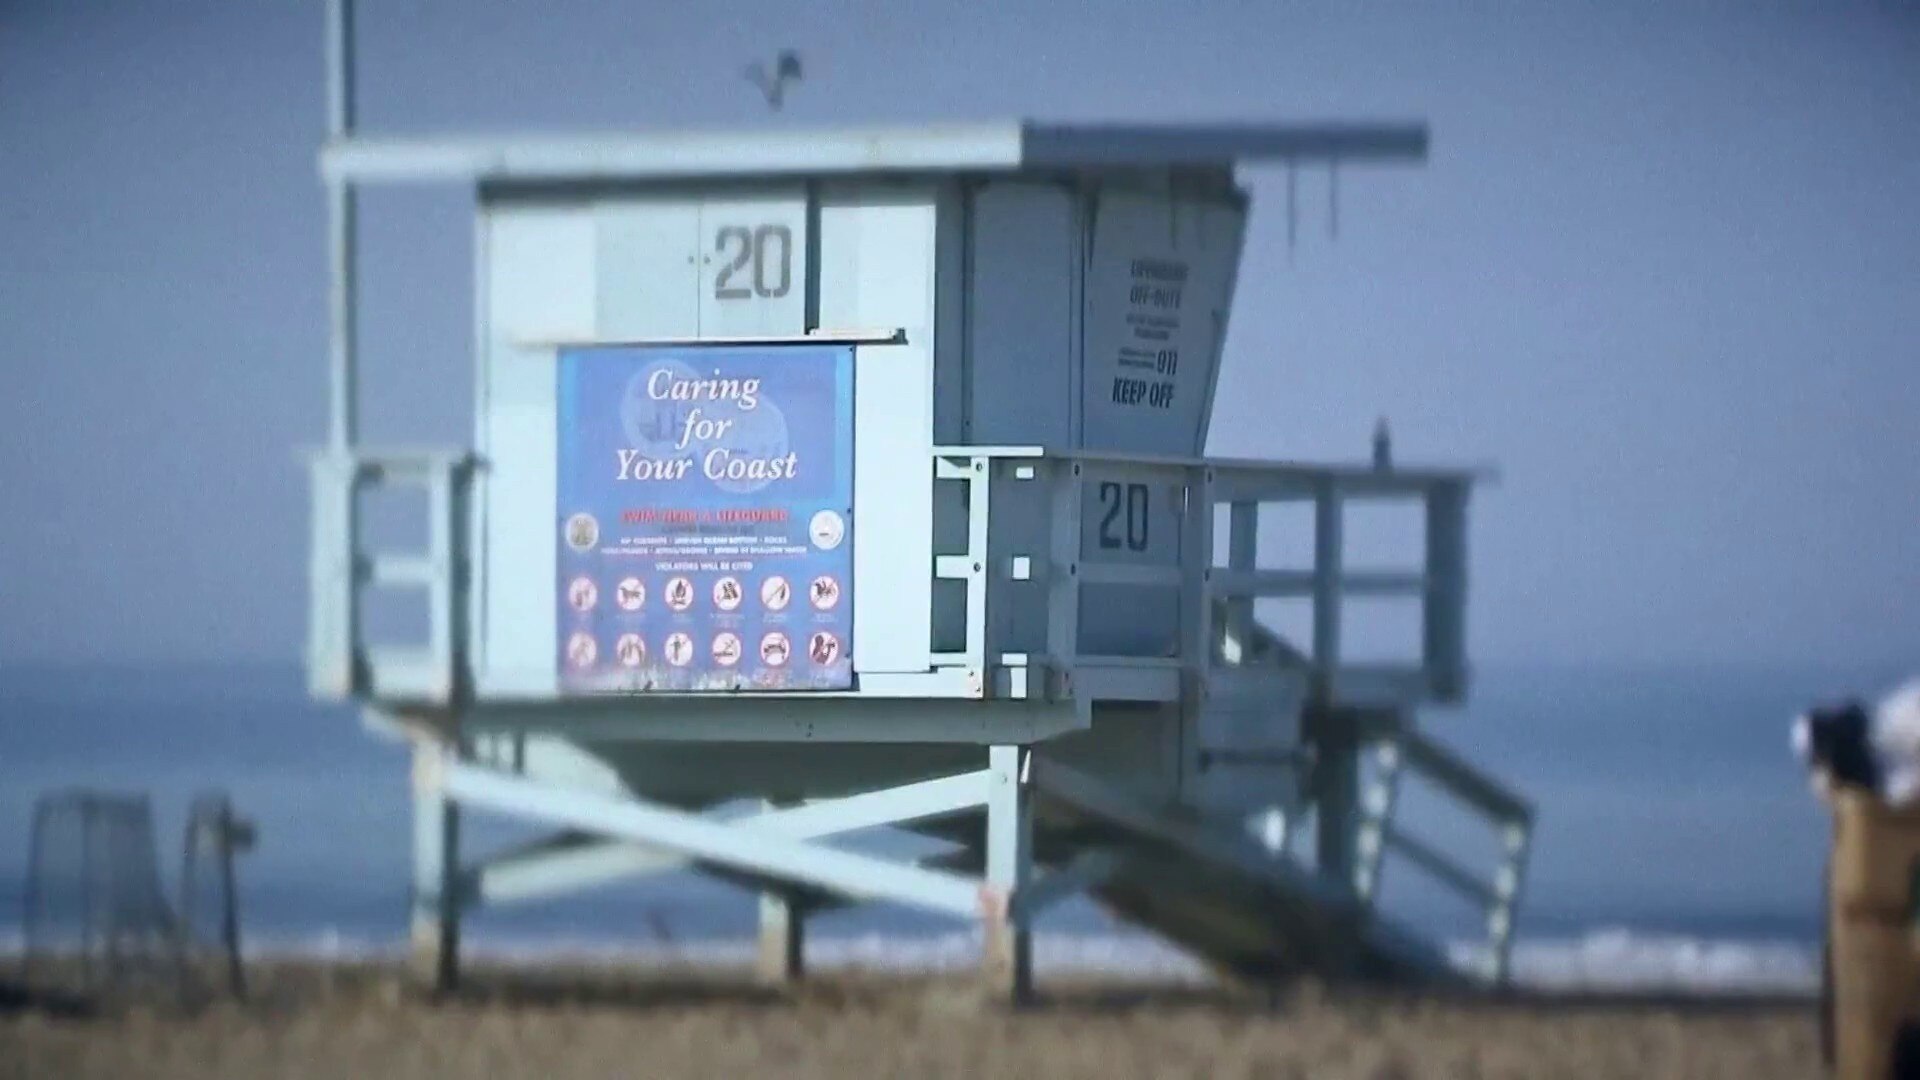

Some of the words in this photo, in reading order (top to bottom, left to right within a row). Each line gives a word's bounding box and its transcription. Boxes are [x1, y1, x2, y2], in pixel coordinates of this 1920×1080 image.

[715, 223, 791, 300] 20
[1157, 349, 1178, 375] 911
[647, 368, 760, 409] Caring
[1112, 377, 1147, 406] KEEP
[1149, 382, 1175, 408] OFF
[675, 408, 732, 450] for
[616, 449, 693, 480] Your
[703, 448, 798, 480] Coast
[1099, 481, 1148, 551] 20
